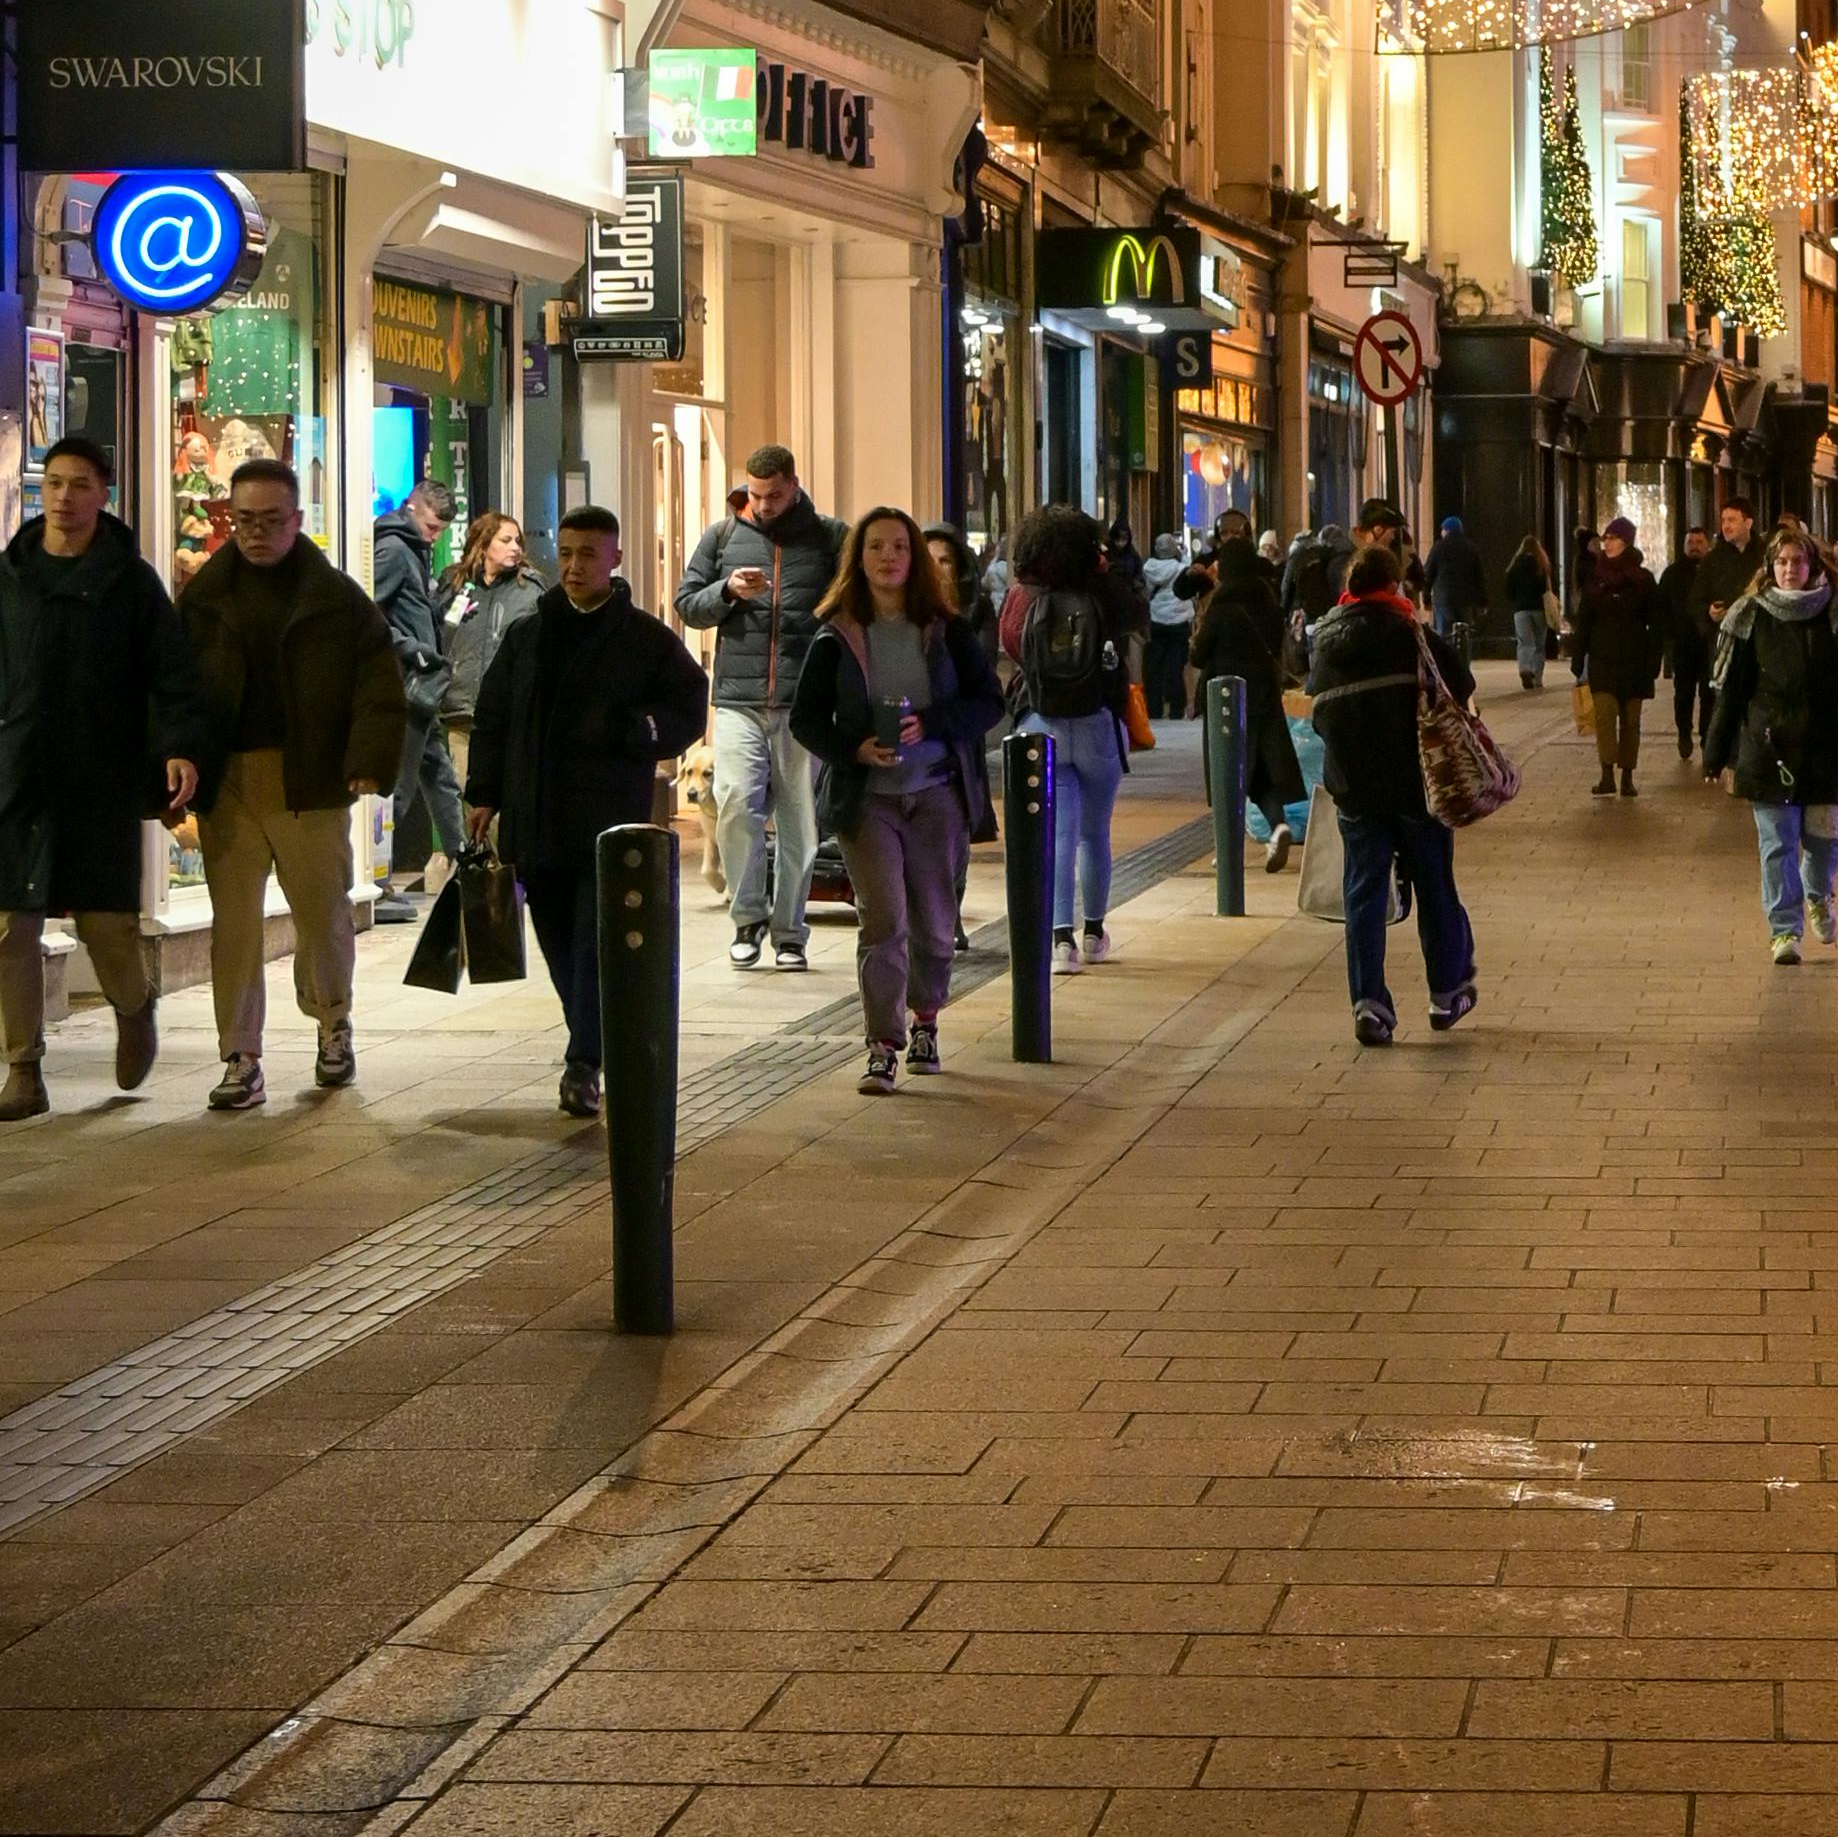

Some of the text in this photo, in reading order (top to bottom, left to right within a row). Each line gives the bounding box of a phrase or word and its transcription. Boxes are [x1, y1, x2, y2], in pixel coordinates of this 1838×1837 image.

[50, 56, 263, 88] SWAROVSKI
[373, 280, 437, 331] OUVENIRS
[374, 322, 444, 374] WNSTAIRS
